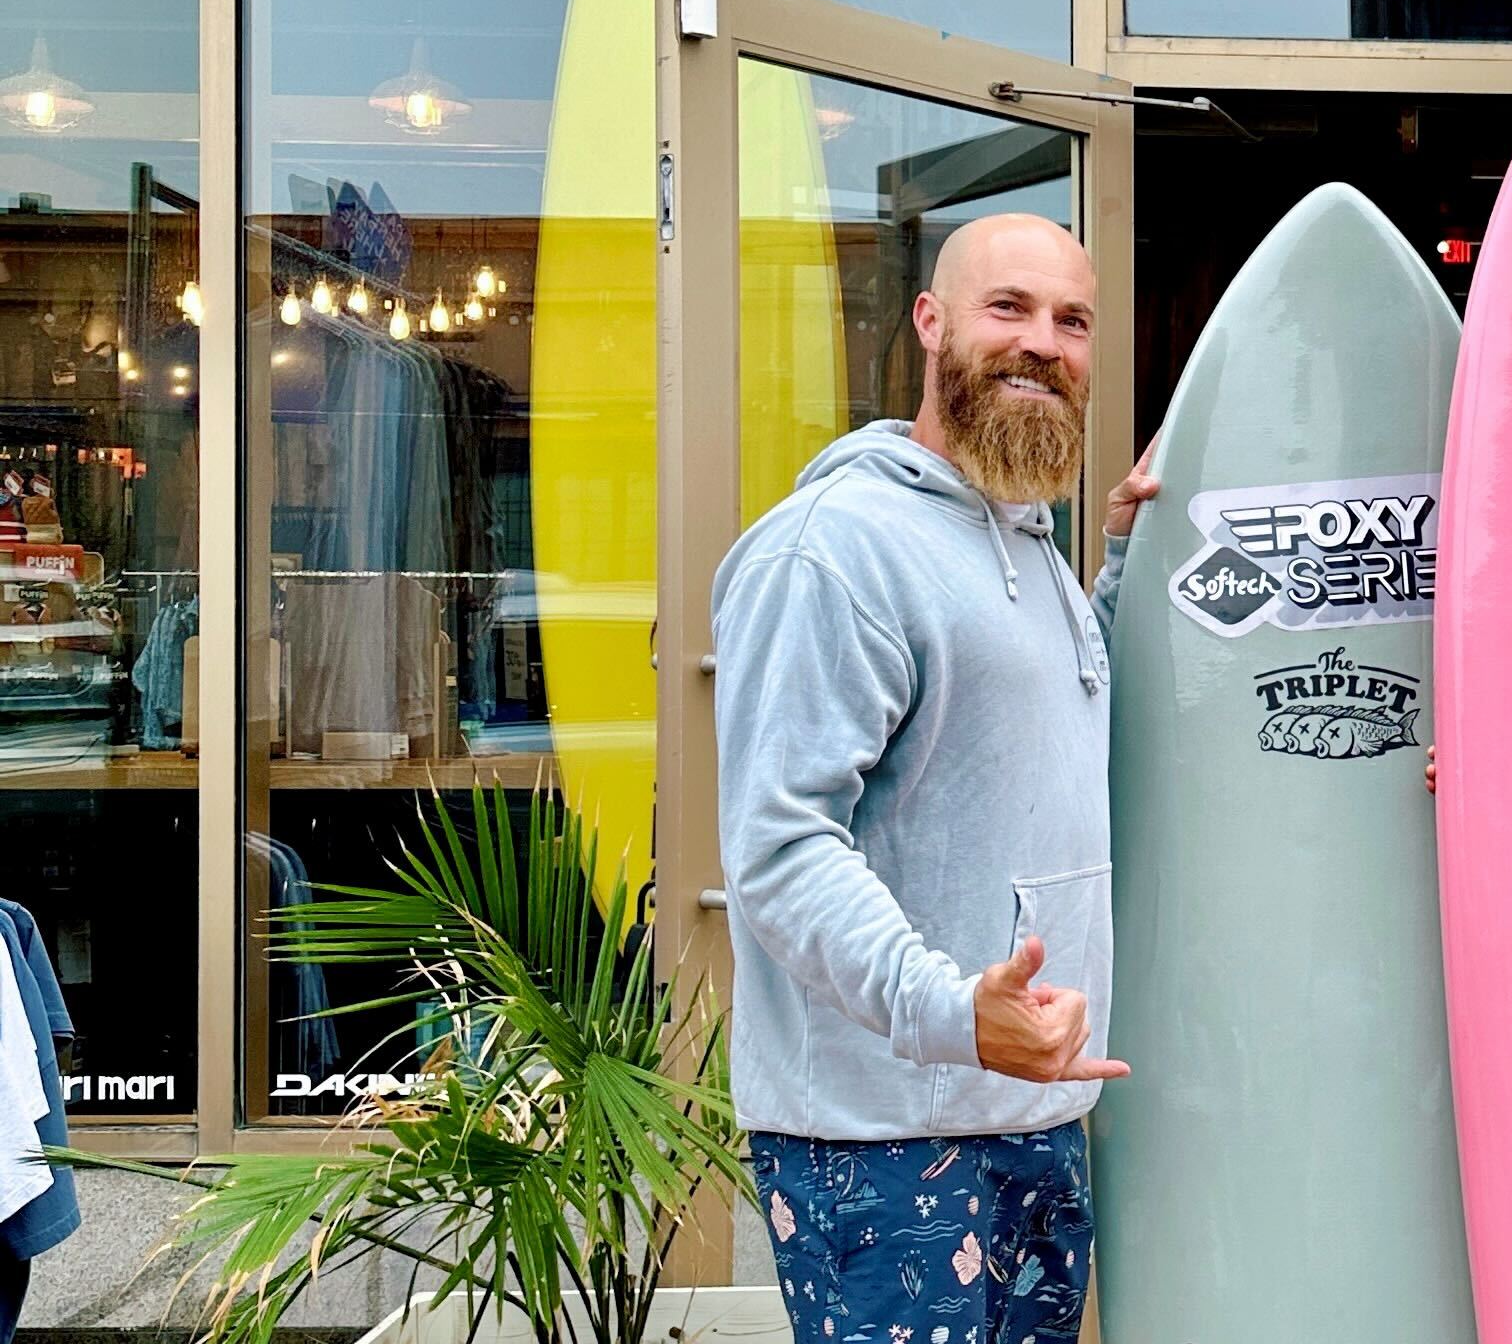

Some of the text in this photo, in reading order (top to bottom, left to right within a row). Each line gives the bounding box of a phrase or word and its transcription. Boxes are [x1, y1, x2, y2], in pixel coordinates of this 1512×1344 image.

[1220, 494, 1435, 557] EPOXY
[1179, 566, 1282, 602] Softech
[1286, 549, 1437, 607] SERIE
[1318, 646, 1355, 673] The
[1256, 674, 1417, 714] TRIPLET
[98, 1075, 175, 1100] mari
